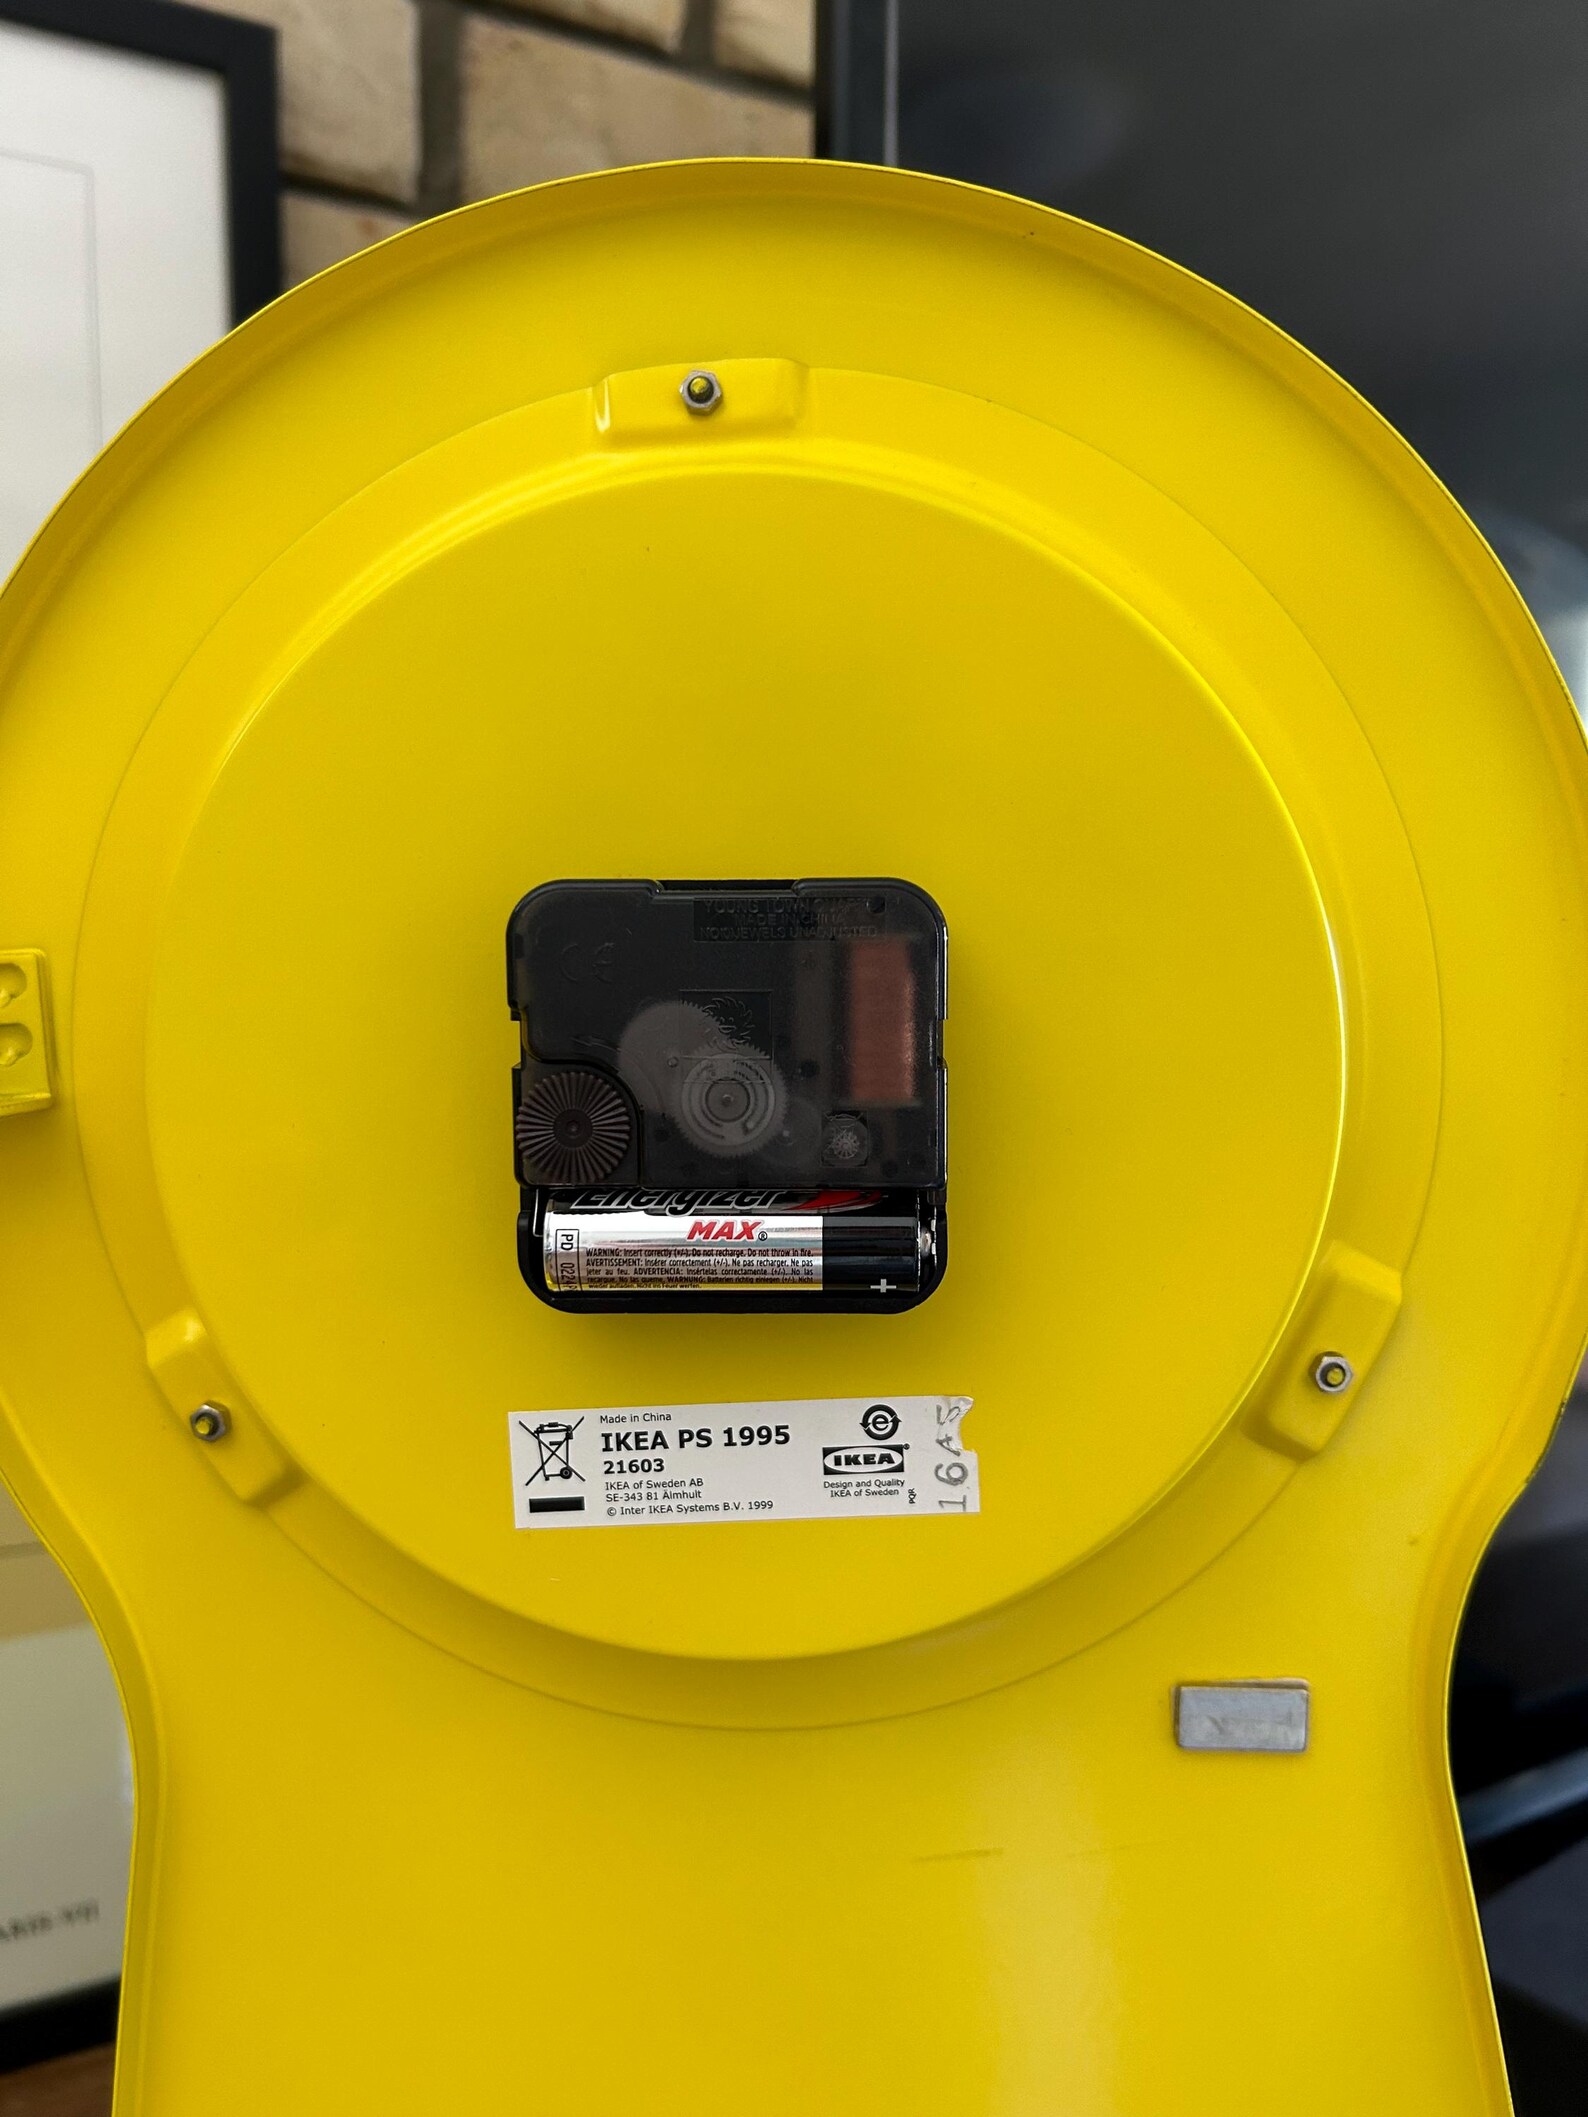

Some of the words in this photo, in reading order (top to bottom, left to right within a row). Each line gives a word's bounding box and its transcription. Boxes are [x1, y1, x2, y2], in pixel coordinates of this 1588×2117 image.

[561, 1234, 574, 1250] PD
[586, 1248, 621, 1257] WARNING:
[623, 1248, 642, 1257] Insert
[644, 1248, 672, 1257] correctly
[692, 1248, 701, 1257] Do
[703, 1248, 713, 1257] not
[716, 1248, 745, 1257] recharge.
[748, 1248, 757, 1257] Do
[759, 1248, 769, 1257] not
[772, 1248, 790, 1257] throw
[793, 1248, 799, 1257] in
[801, 1248, 813, 1257] fire.
[586, 1258, 643, 1267] AVERTISSEMENT:
[669, 1258, 711, 1267] correctement
[732, 1258, 741, 1267] Ne
[743, 1258, 754, 1267] pas
[757, 1258, 789, 1267] recharger.
[791, 1258, 800, 1267] Ne
[802, 1258, 813, 1267] pas
[586, 1267, 601, 1276] jeter
[605, 1267, 614, 1276] au
[633, 1267, 683, 1276] ADVERTENCIA:
[721, 1267, 768, 1276] correctamente
[792, 1267, 801, 1276] No
[804, 1267, 813, 1276] las
[600, 1414, 627, 1424] Made
[630, 1414, 640, 1423] in
[643, 1413, 672, 1422] China
[601, 1430, 669, 1452] IKEA
[678, 1428, 713, 1449] PS
[723, 1425, 790, 1447] 1995
[833, 1453, 895, 1466] IKEA
[604, 1458, 665, 1475] 21603
[605, 1481, 630, 1490] IKEA
[633, 1480, 643, 1489] of
[646, 1479, 686, 1489] Sweden
[689, 1478, 704, 1487] AB
[823, 1480, 853, 1491] Design
[855, 1479, 872, 1488] and
[874, 1478, 905, 1489] Quality
[606, 1492, 643, 1502] SE-343
[646, 1491, 658, 1501] 81
[663, 1489, 702, 1500] Älmhult
[830, 1488, 852, 1498] IKEA
[854, 1488, 864, 1497] of
[865, 1488, 899, 1497] Sweden
[908, 1488, 917, 1504] PQR
[620, 1506, 645, 1515] Inter
[649, 1504, 672, 1514] IKEA
[676, 1503, 720, 1515] Systems
[723, 1501, 744, 1511] B.V.
[748, 1500, 773, 1511] 1999
